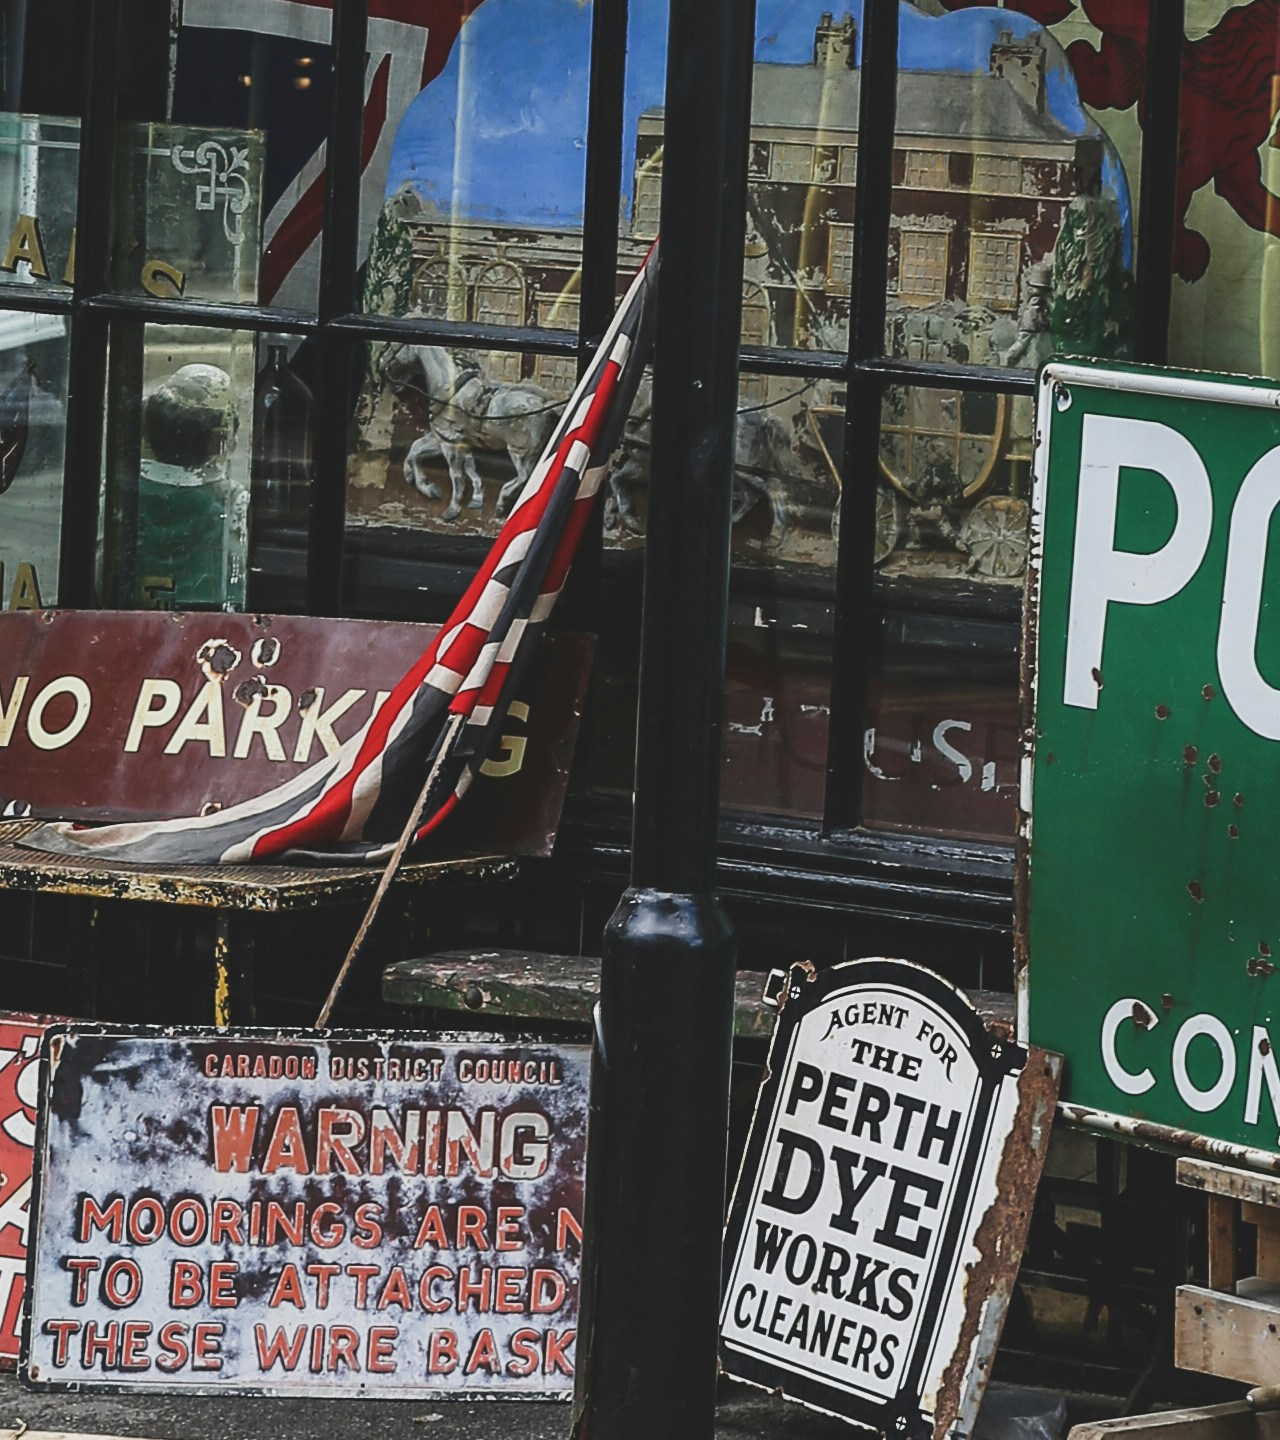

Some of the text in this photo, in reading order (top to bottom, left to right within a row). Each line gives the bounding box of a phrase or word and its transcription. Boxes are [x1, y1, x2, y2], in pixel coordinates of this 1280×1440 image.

[123, 676, 529, 779] PARKG
[205, 1053, 563, 1085] CARADON DISTRICT COUNCIL
[820, 1002, 959, 1083] AGENT FOR
[850, 1037, 923, 1082] THE
[211, 1104, 551, 1180] WARNING
[784, 1061, 962, 1166] PERTH
[79, 1195, 382, 1249] MOORINGS
[415, 1204, 526, 1252] ARE
[761, 1127, 945, 1260] DYE
[67, 1257, 566, 1314] TO BE ATTACHED
[753, 1218, 920, 1322] WORKS
[45, 1319, 223, 1372] THESE
[254, 1322, 399, 1374] WIRE
[733, 1282, 901, 1381] CLEANERS
